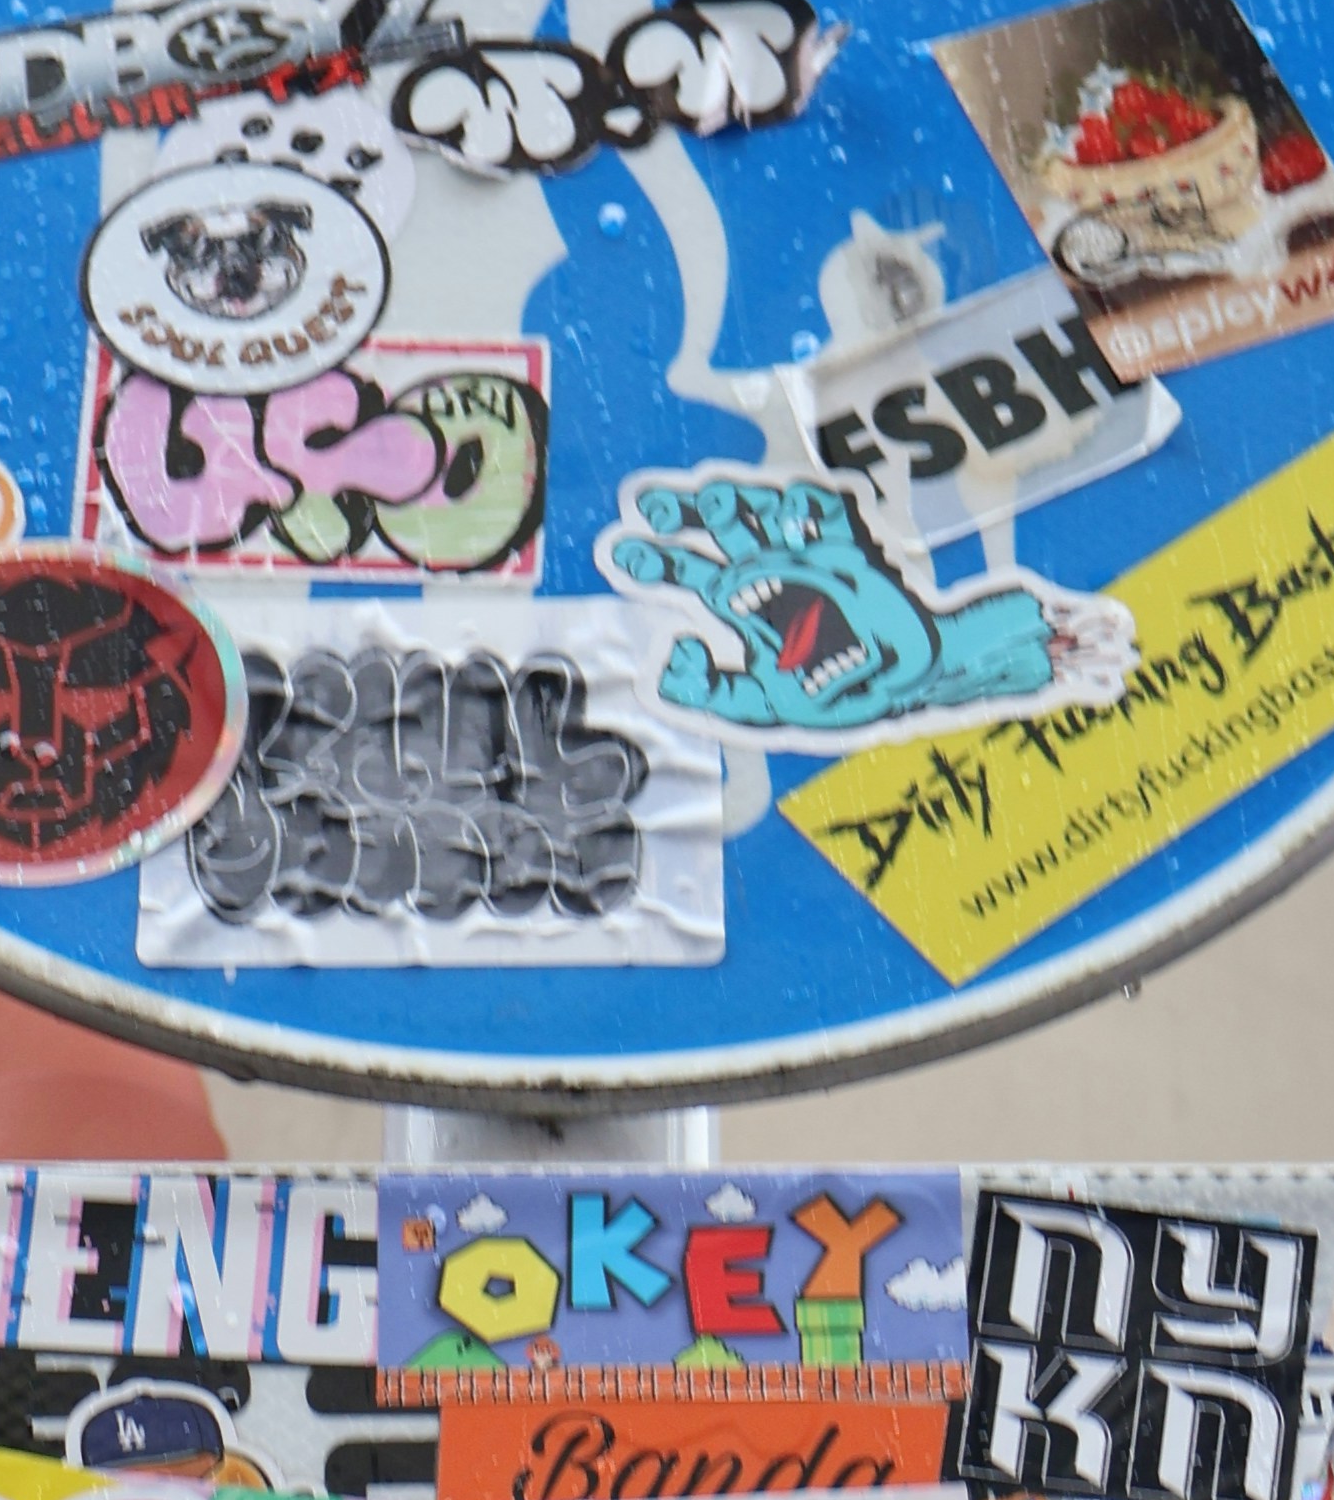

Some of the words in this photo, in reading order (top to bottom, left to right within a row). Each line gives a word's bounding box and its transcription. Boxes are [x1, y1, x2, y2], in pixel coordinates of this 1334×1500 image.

[817, 742, 995, 891] Dirty
[438, 1190, 907, 1346] OKEY
[114, 1409, 146, 1452] LA
